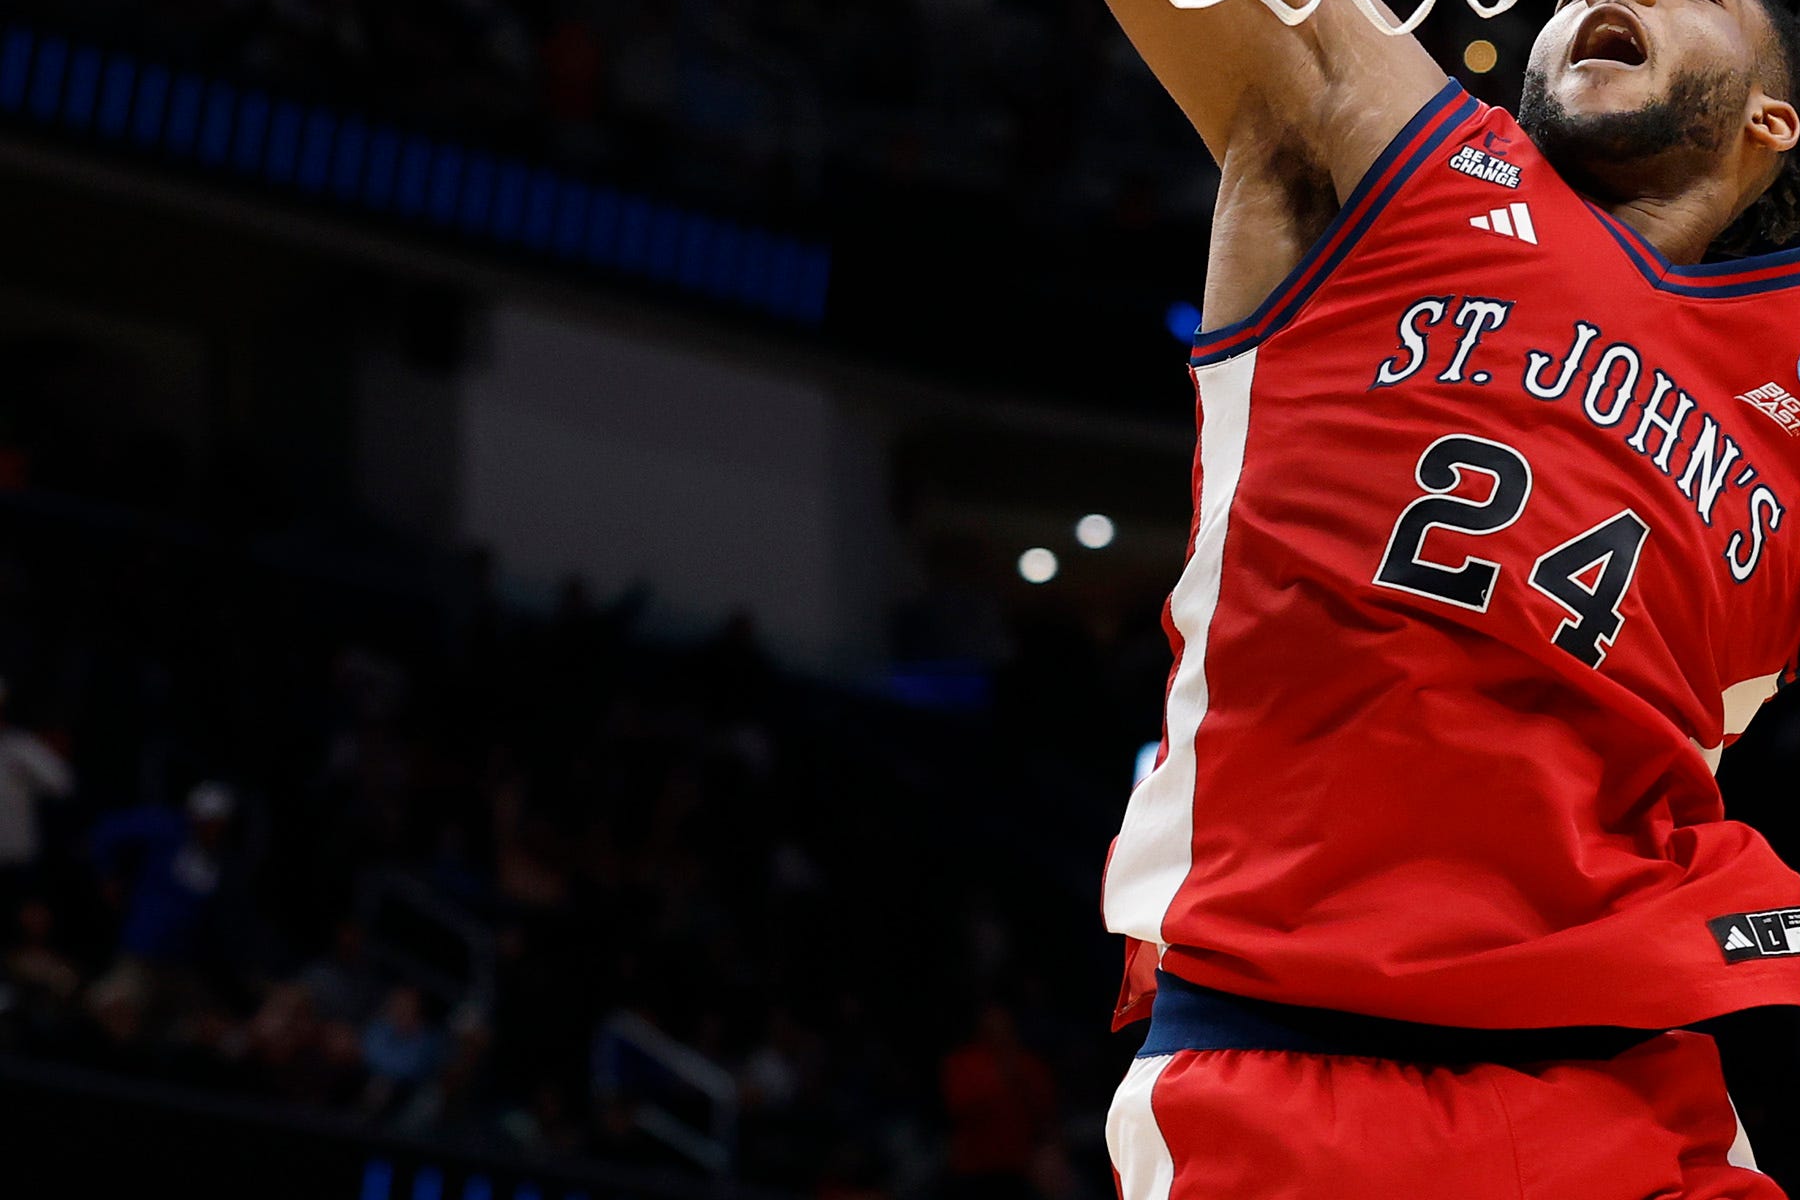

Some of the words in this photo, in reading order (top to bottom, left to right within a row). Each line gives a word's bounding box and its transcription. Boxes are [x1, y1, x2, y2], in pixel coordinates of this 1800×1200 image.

[1449, 155, 1520, 188] CHANGE
[1460, 145, 1486, 164] BE
[1489, 156, 1521, 177] THE
[1368, 295, 1515, 390] ST.
[1523, 321, 1784, 583] JOHN'S
[1372, 433, 1652, 671] 24
[1768, 929, 1781, 946] L
